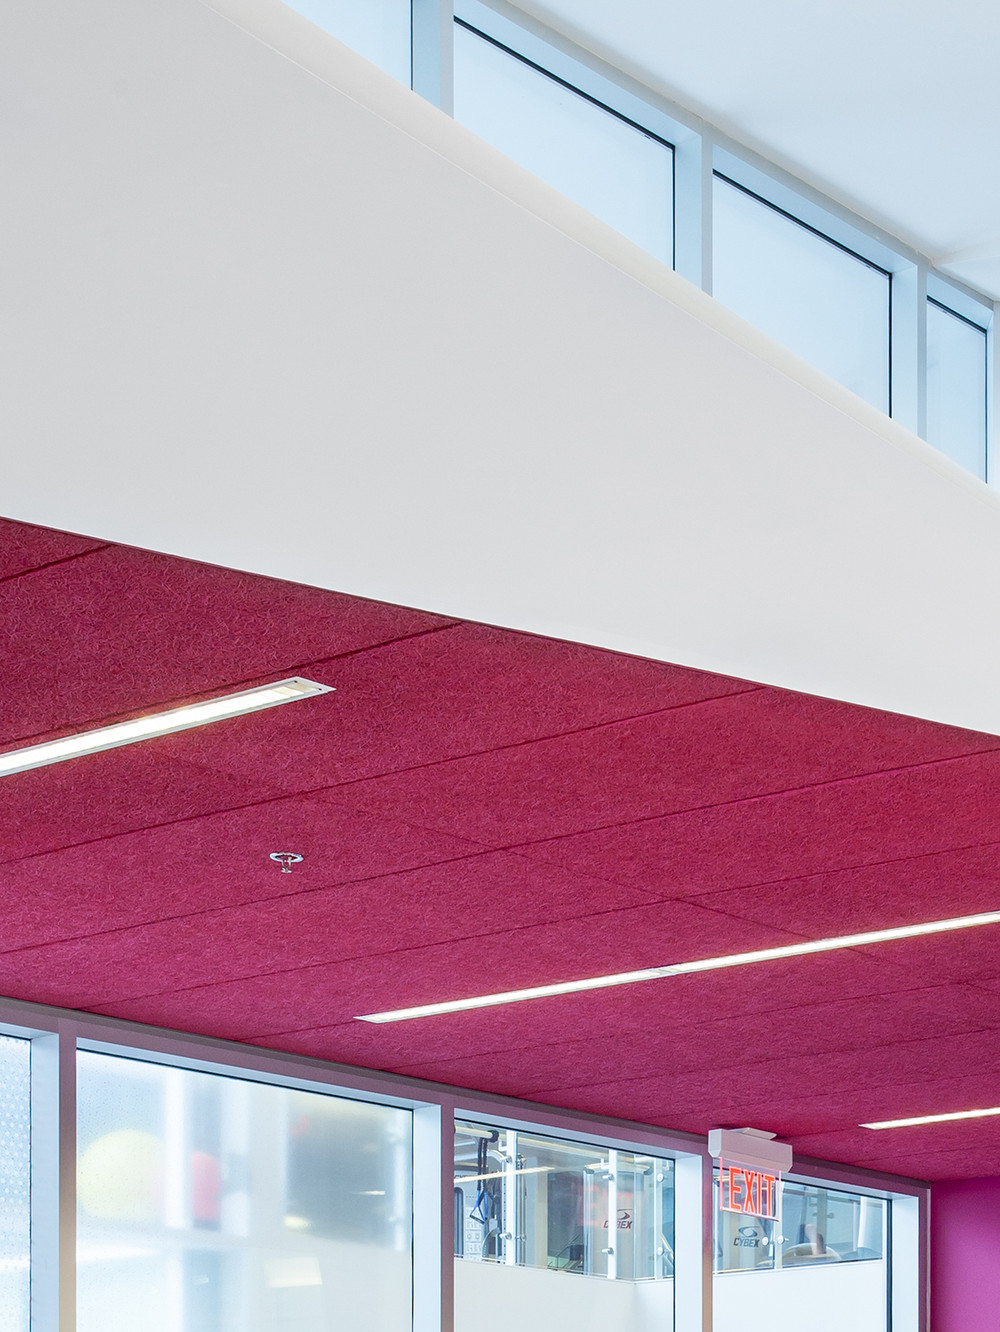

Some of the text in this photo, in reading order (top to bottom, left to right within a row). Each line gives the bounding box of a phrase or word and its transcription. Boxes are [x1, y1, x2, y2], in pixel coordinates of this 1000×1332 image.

[729, 1166, 776, 1217] EXIT
[603, 1220, 633, 1229] CBEX
[733, 1237, 760, 1248] CYBEX
